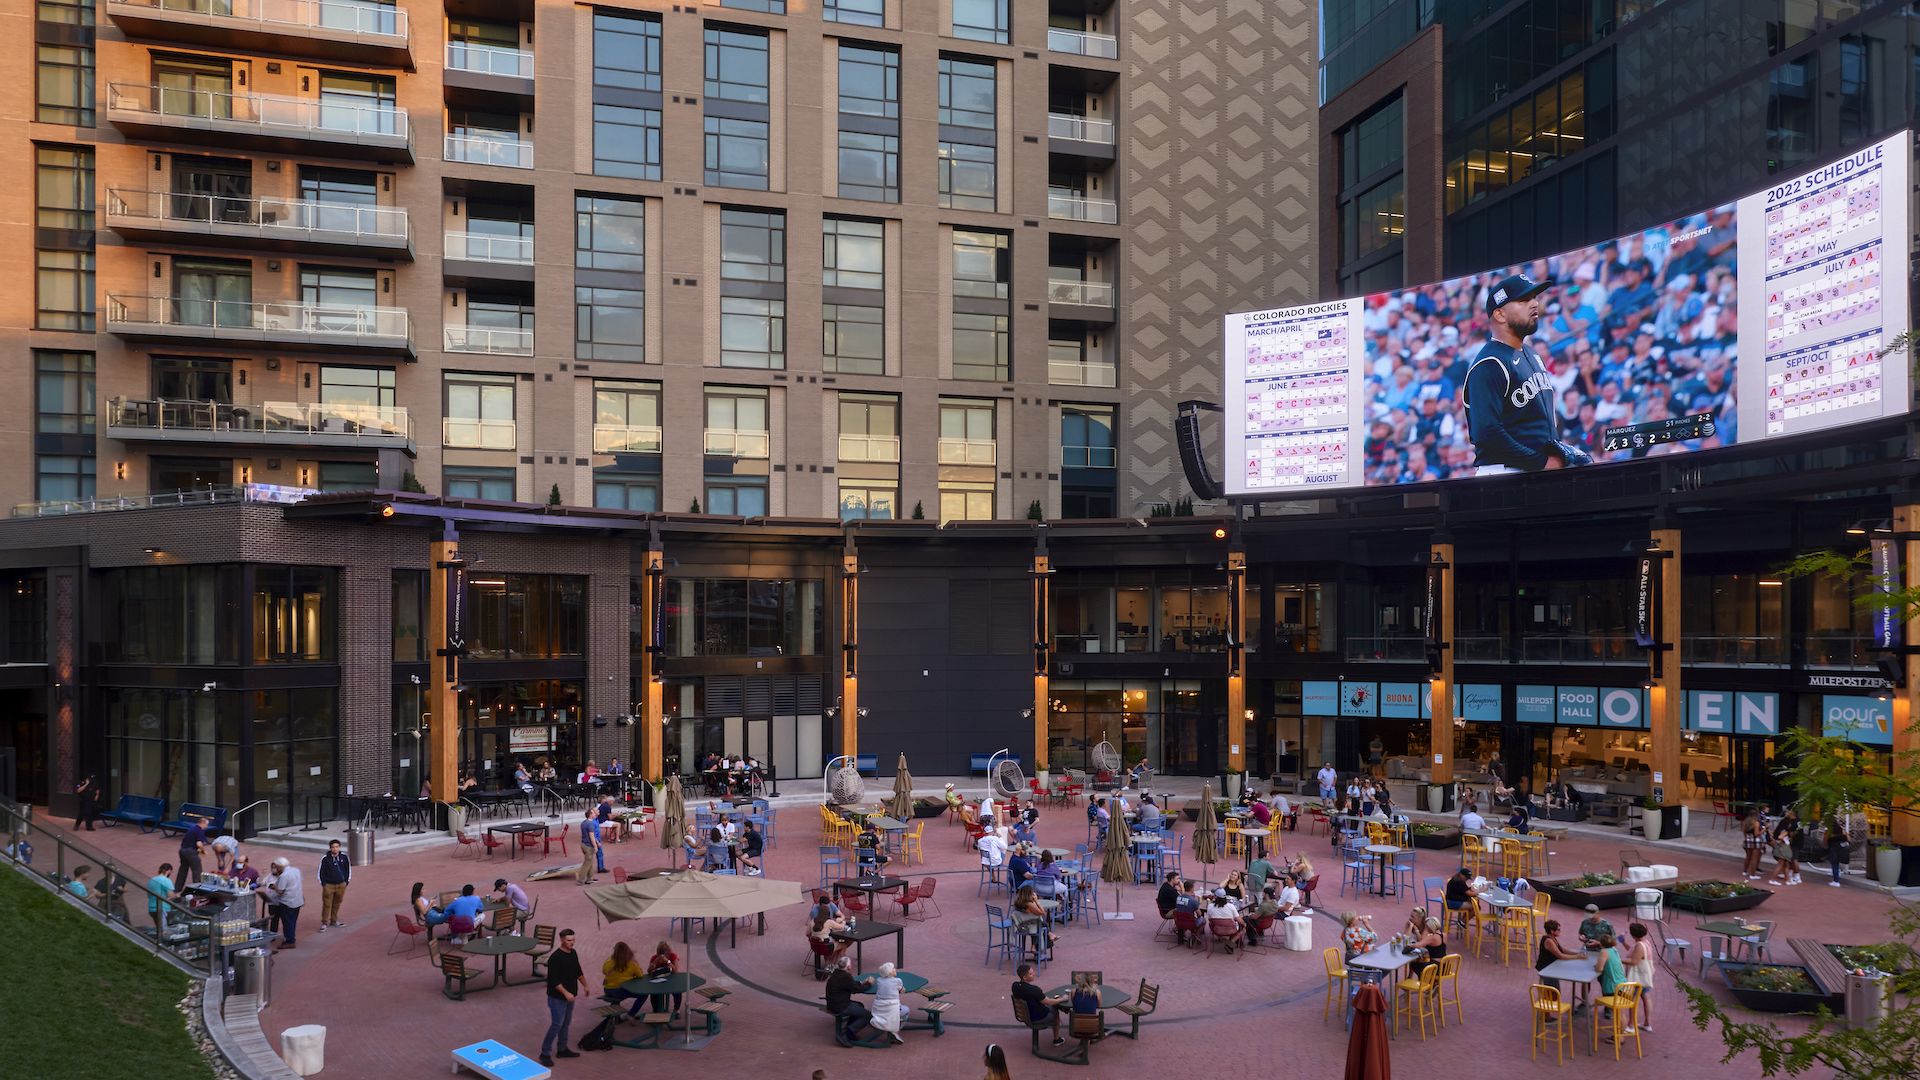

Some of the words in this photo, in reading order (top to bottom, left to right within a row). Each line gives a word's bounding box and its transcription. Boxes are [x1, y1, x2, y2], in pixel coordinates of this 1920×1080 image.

[1767, 180, 1801, 203] 2022
[1805, 145, 1883, 188] SCHEDULE
[1670, 225, 1713, 245] SPORTSNET
[1817, 240, 1838, 254] MAY
[1824, 260, 1845, 275] JULY
[1253, 308, 1305, 321] COLORADO
[1307, 302, 1347, 314] ROCKIES
[1247, 324, 1302, 337] MARCH/APRIL
[1786, 350, 1830, 369] SEPT/OCT
[1268, 382, 1288, 391] JUNE
[1621, 438, 1628, 447] 3
[1649, 433, 1656, 443] 2
[1305, 474, 1338, 483] AUGUST
[1639, 575, 1648, 611] ALL-STAR
[1808, 675, 1865, 687] MILEPOST
[1386, 694, 1413, 703] BUONA
[1517, 696, 1554, 704] MILEPOST
[1560, 693, 1595, 704] FOOD
[1562, 707, 1593, 717] HALL
[1828, 704, 1879, 724] pour
